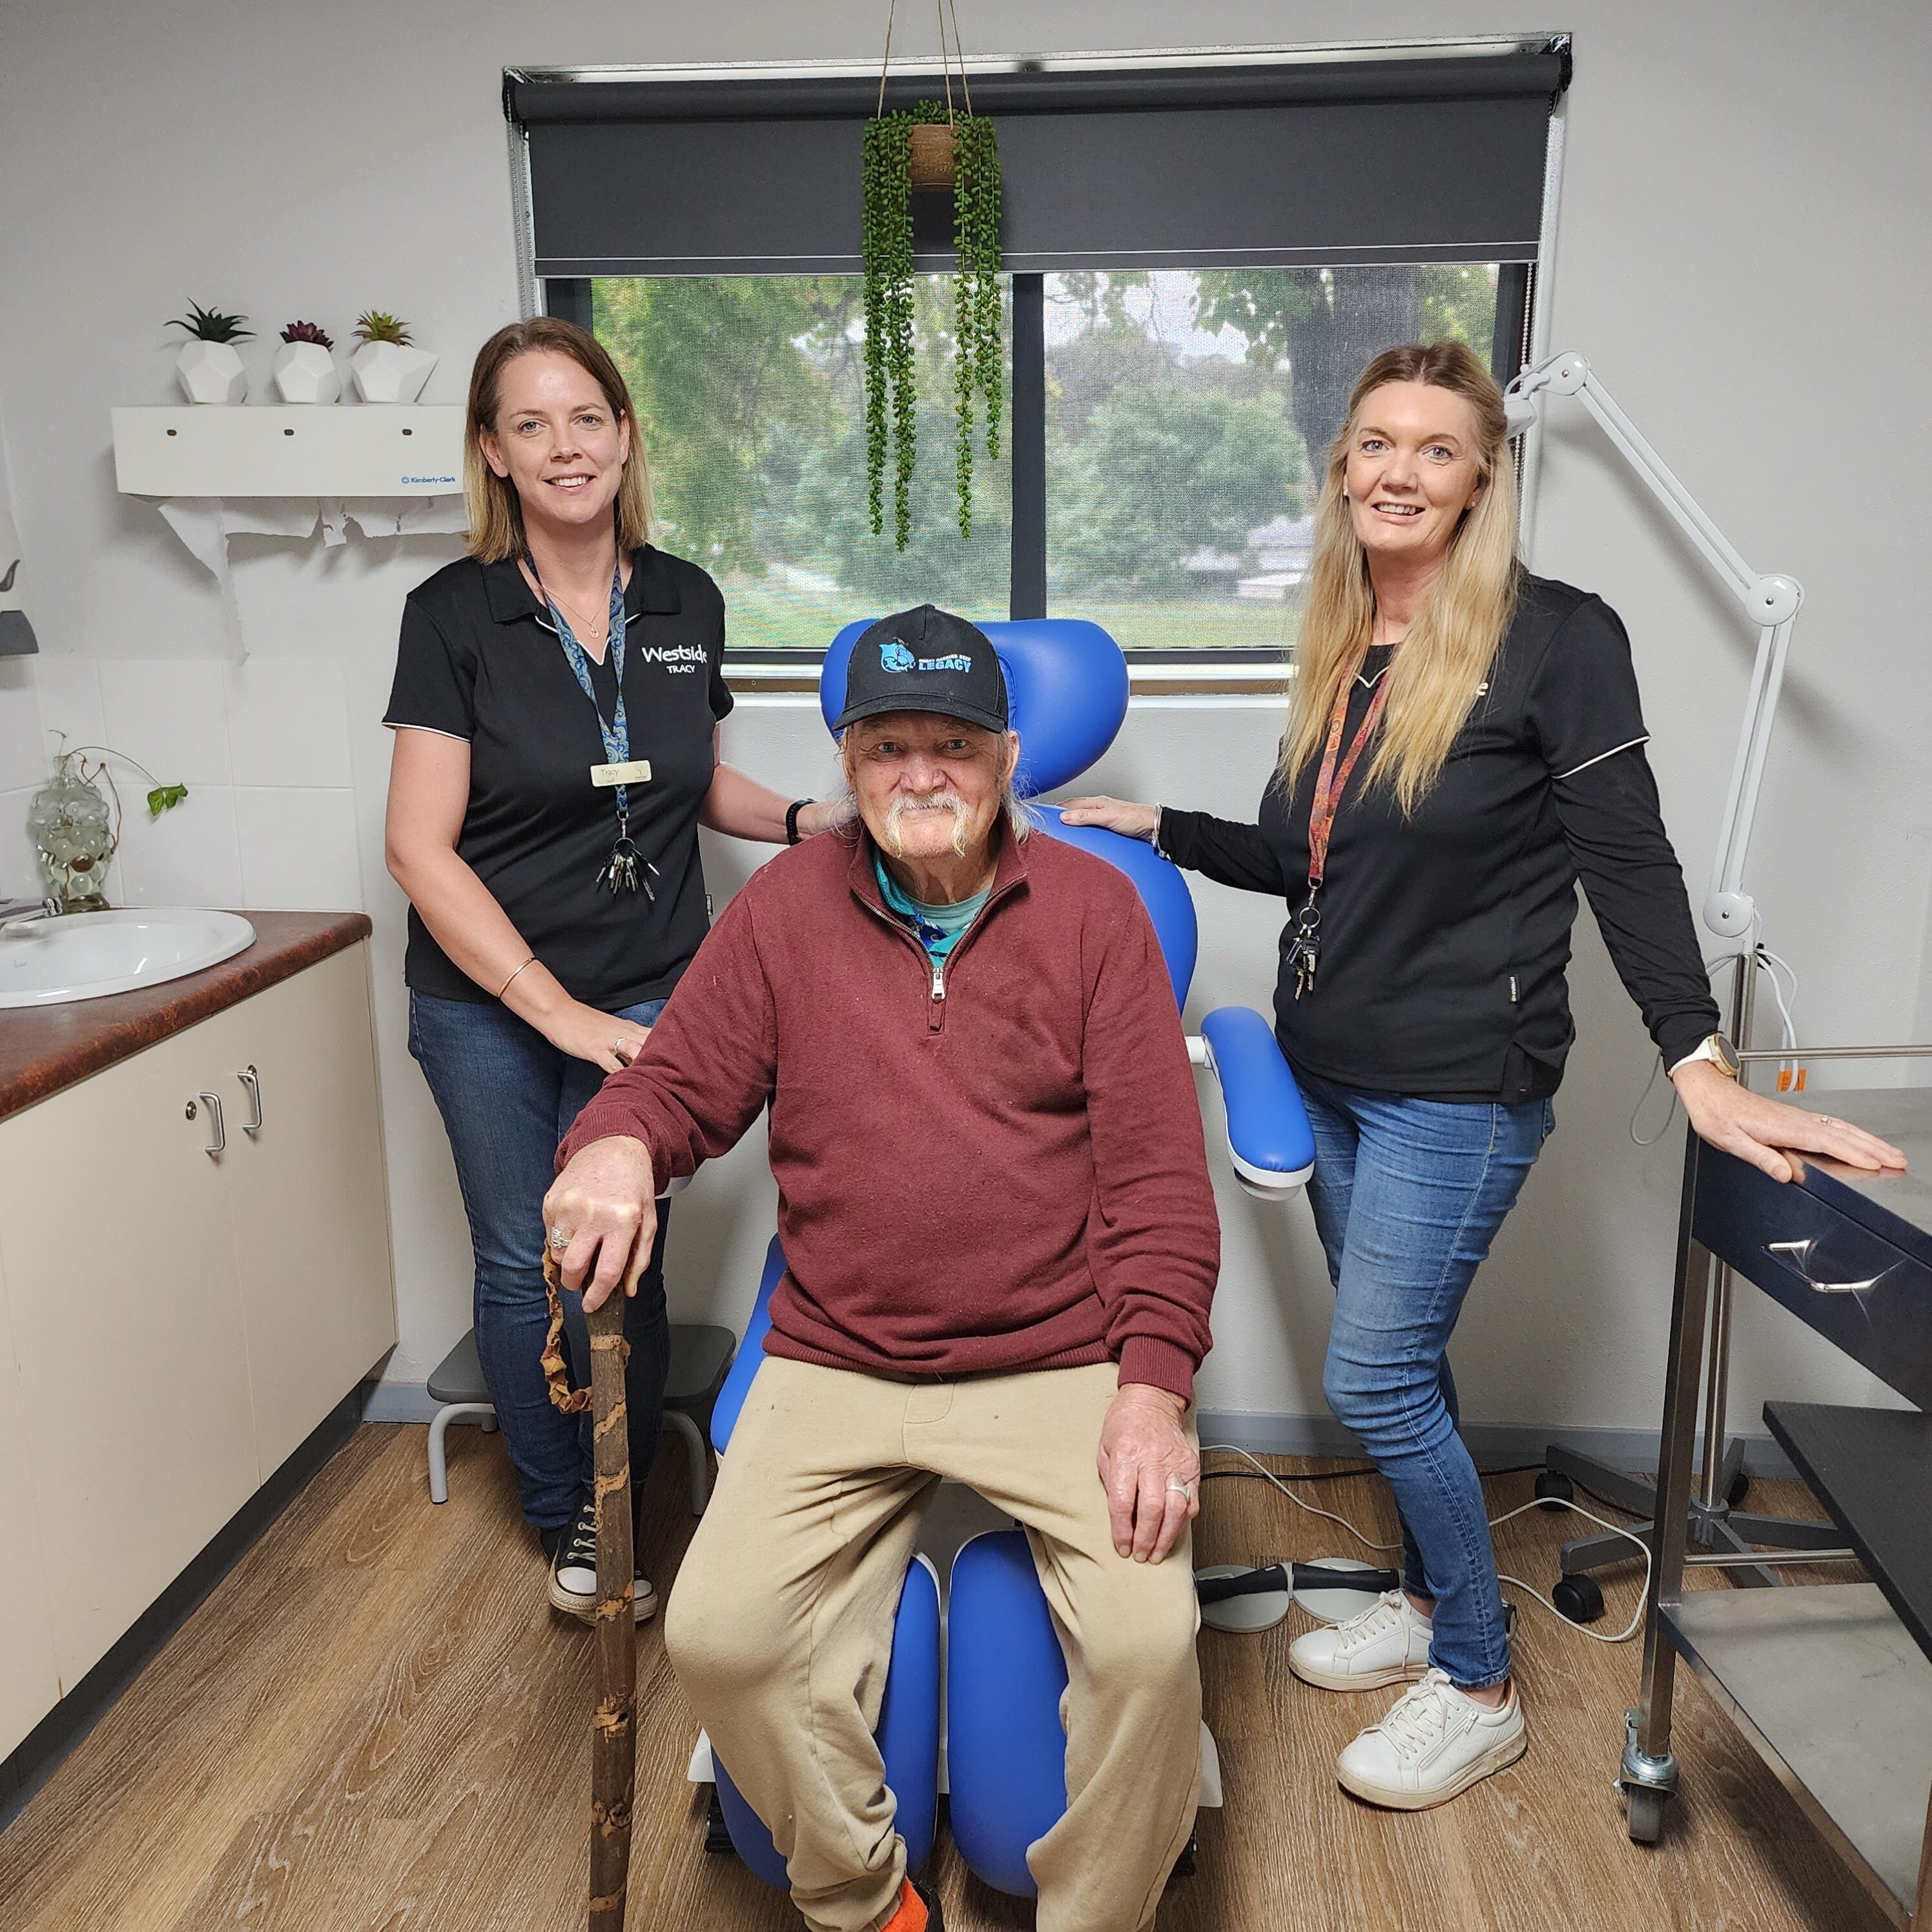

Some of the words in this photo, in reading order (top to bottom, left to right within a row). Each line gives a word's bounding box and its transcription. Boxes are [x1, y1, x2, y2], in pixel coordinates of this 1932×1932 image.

[641, 644, 707, 664] Westside
[666, 664, 695, 674] TRACY
[918, 659, 972, 673] LEGACY
[601, 768, 619, 777] Tracy
